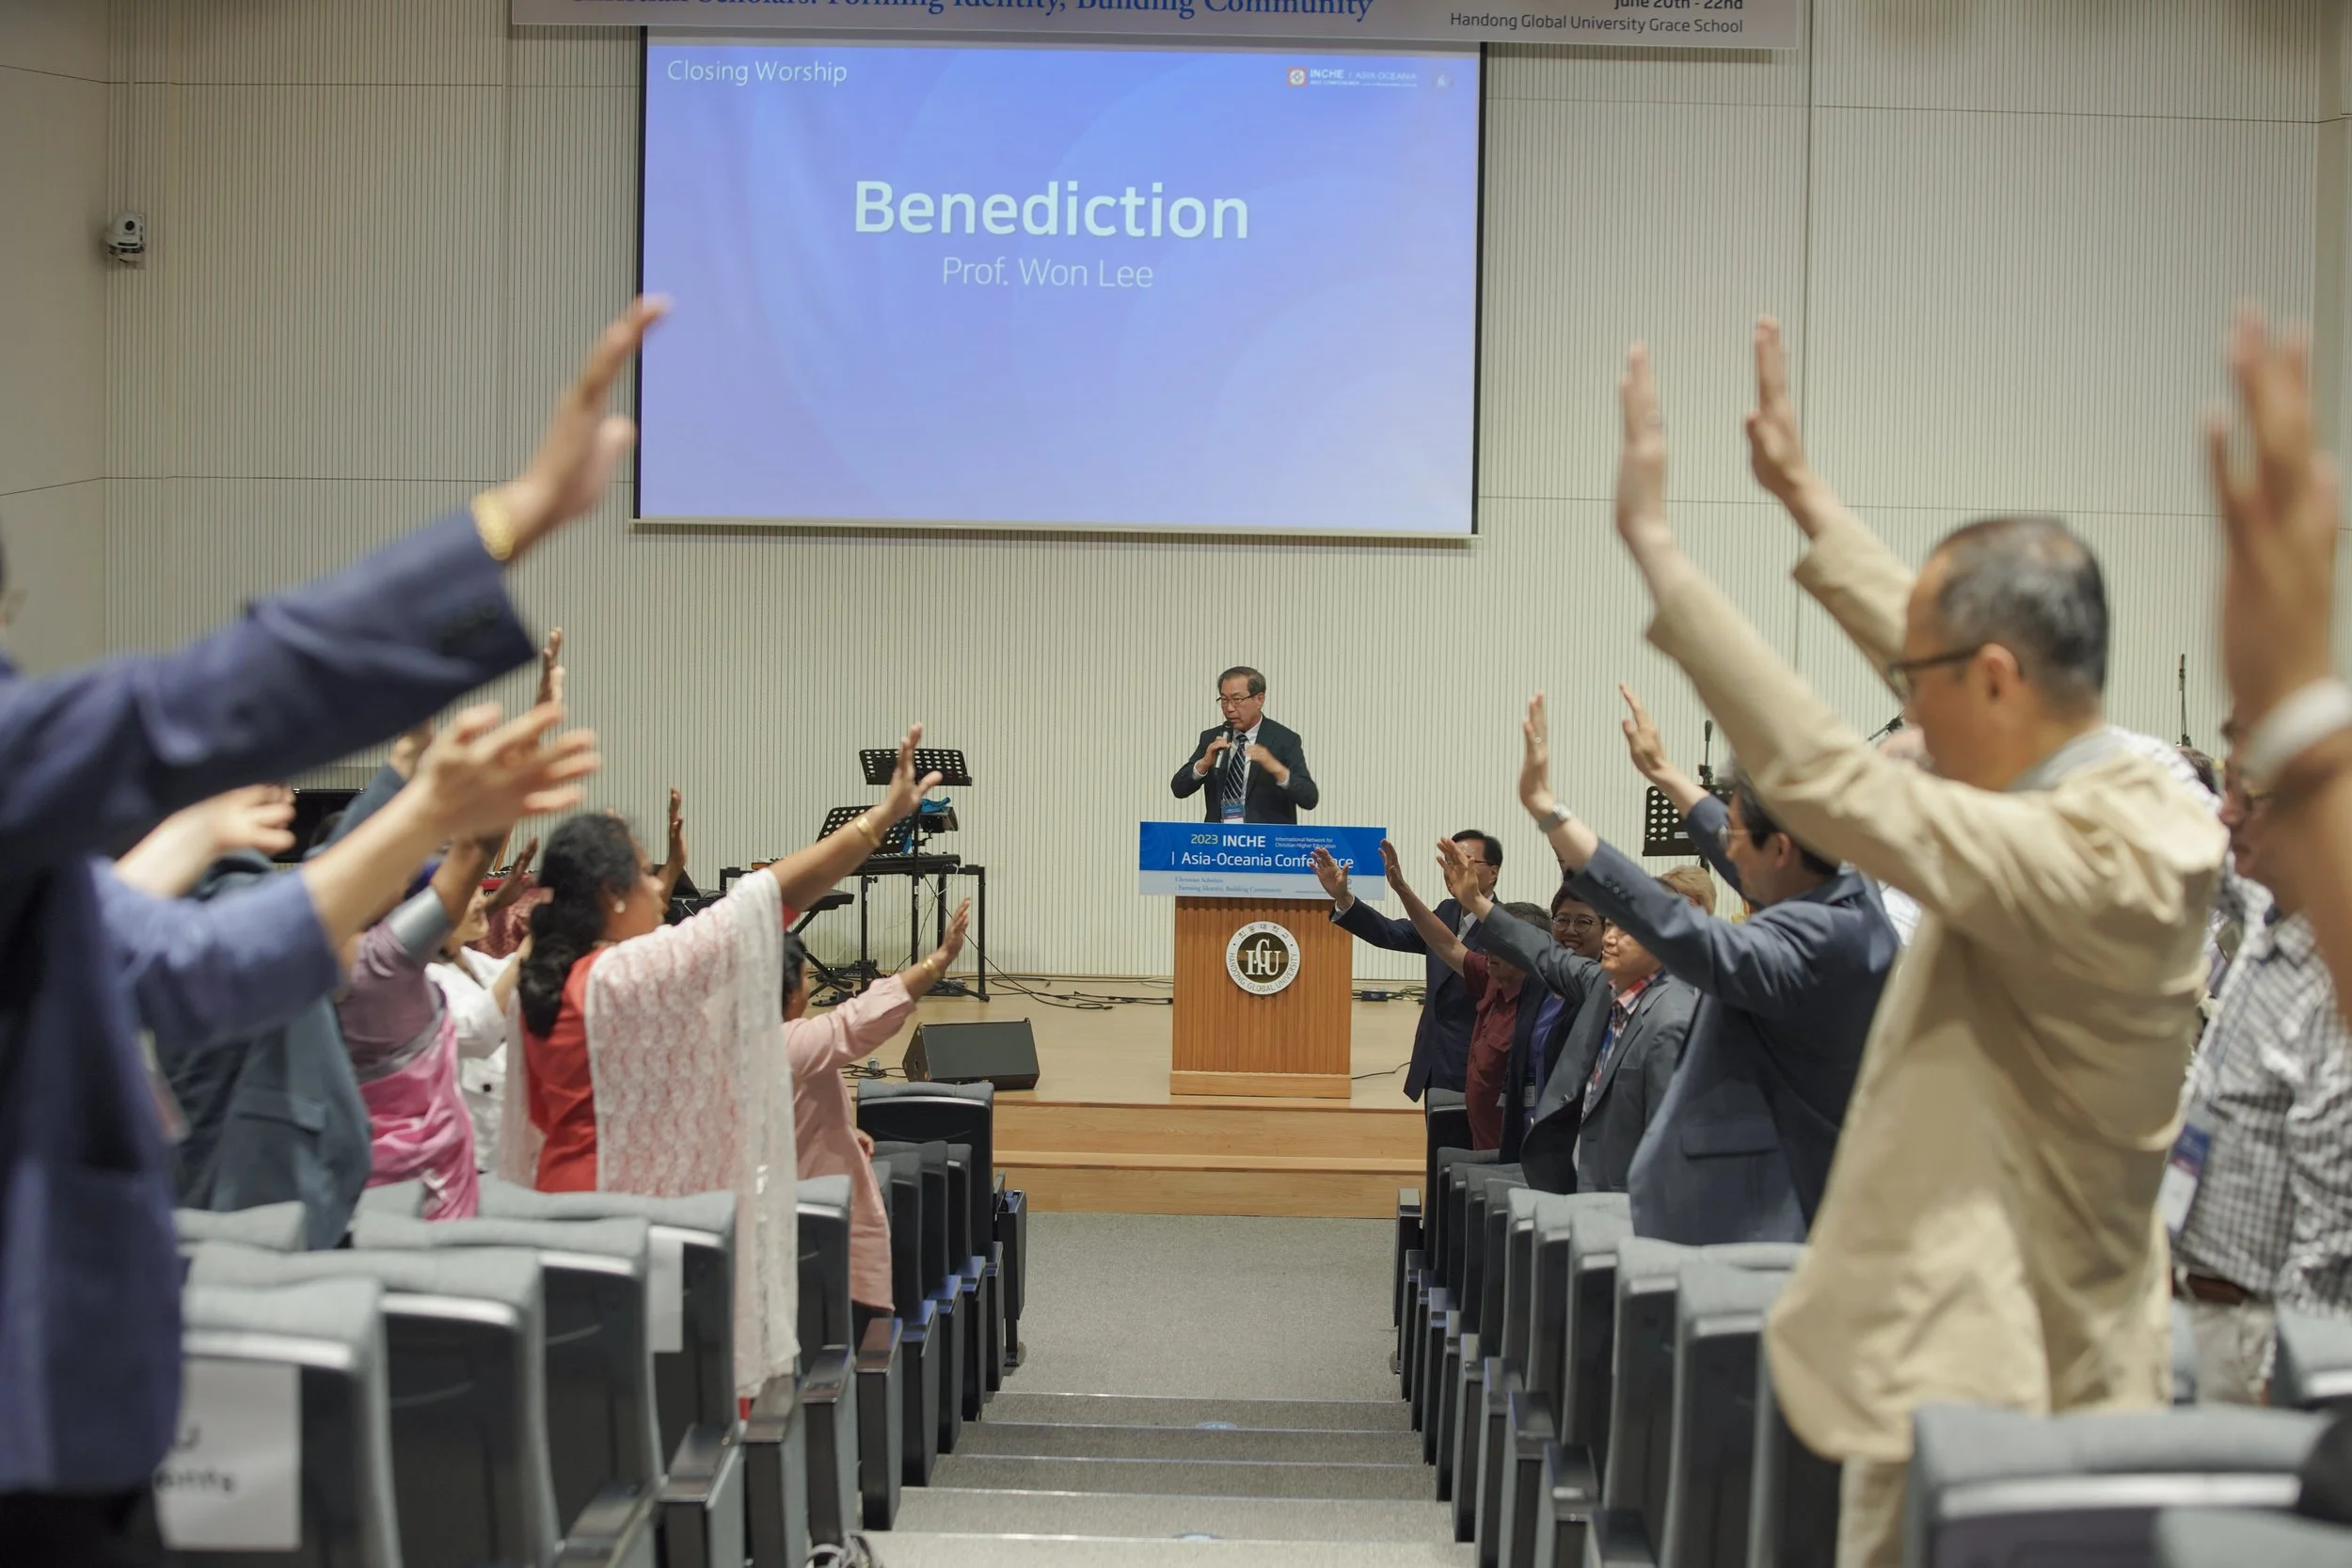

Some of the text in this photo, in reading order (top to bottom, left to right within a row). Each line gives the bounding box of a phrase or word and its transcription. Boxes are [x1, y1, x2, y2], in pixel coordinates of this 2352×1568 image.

[953, 0, 1067, 17] entty,
[1204, 0, 1374, 23] Community
[1614, 0, 1649, 9] June
[1450, 12, 1743, 35] Handong Global University Grace School
[667, 59, 848, 87] Closing Worship
[1310, 69, 1344, 79] INCHE
[855, 180, 1248, 239] Benediction
[943, 256, 1154, 288] Prof. Won Lee
[1190, 833, 1266, 847] 2023 INCHE
[1181, 851, 1354, 869] Asia-Oceania Confece
[1247, 982, 1276, 992] GLOBAL
[1275, 953, 1298, 989] UNIVERSITY
